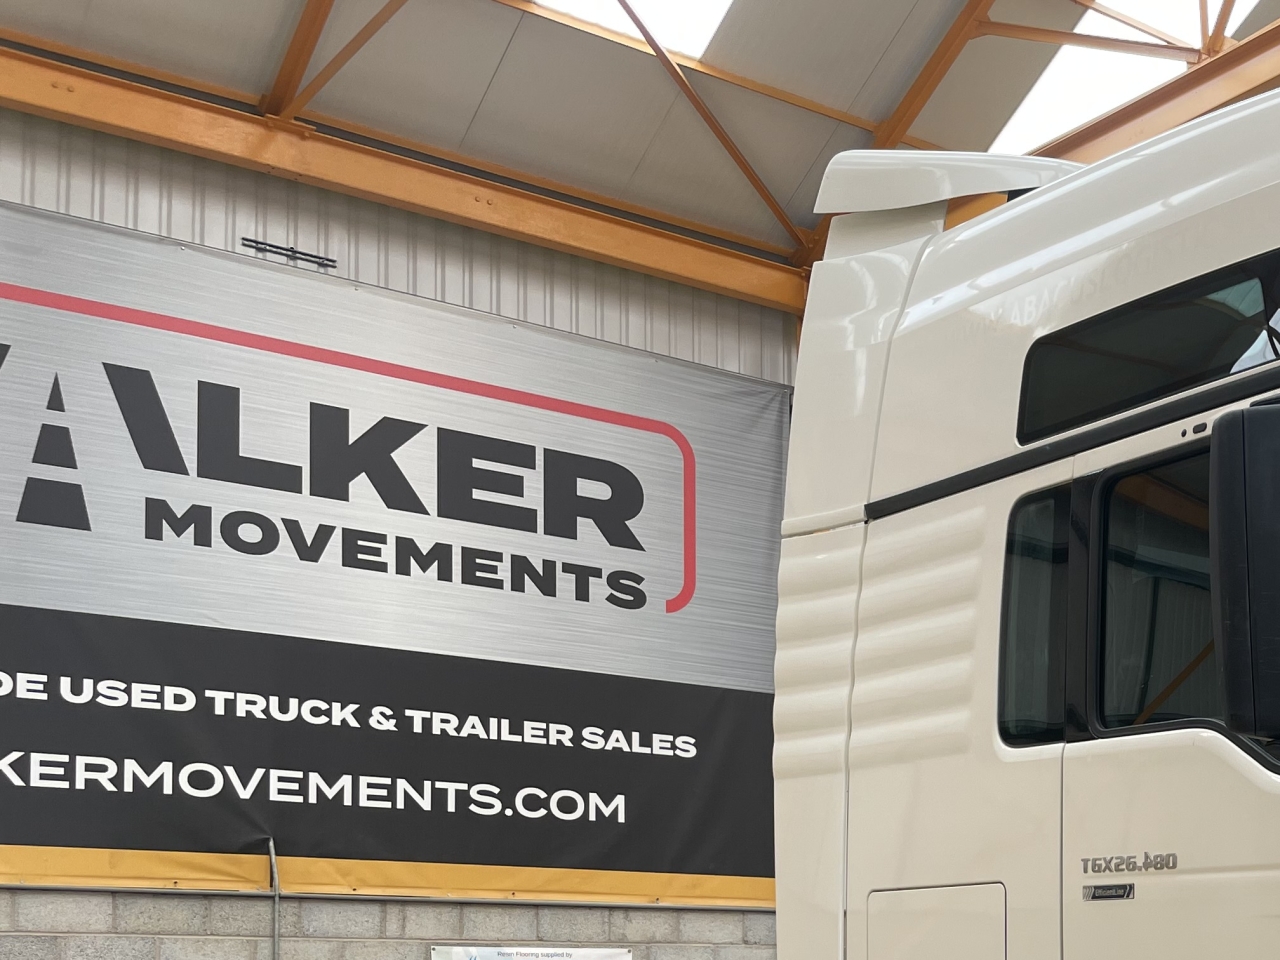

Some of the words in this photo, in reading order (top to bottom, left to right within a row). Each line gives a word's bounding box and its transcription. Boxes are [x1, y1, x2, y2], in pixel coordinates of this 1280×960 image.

[0, 343, 646, 552] ALKER
[144, 497, 647, 610] MOVEMENTS
[59, 676, 197, 712] USED
[204, 689, 361, 728] TRUCK
[368, 705, 398, 731] &
[404, 709, 574, 747] TRAILER
[580, 726, 697, 758] SALES
